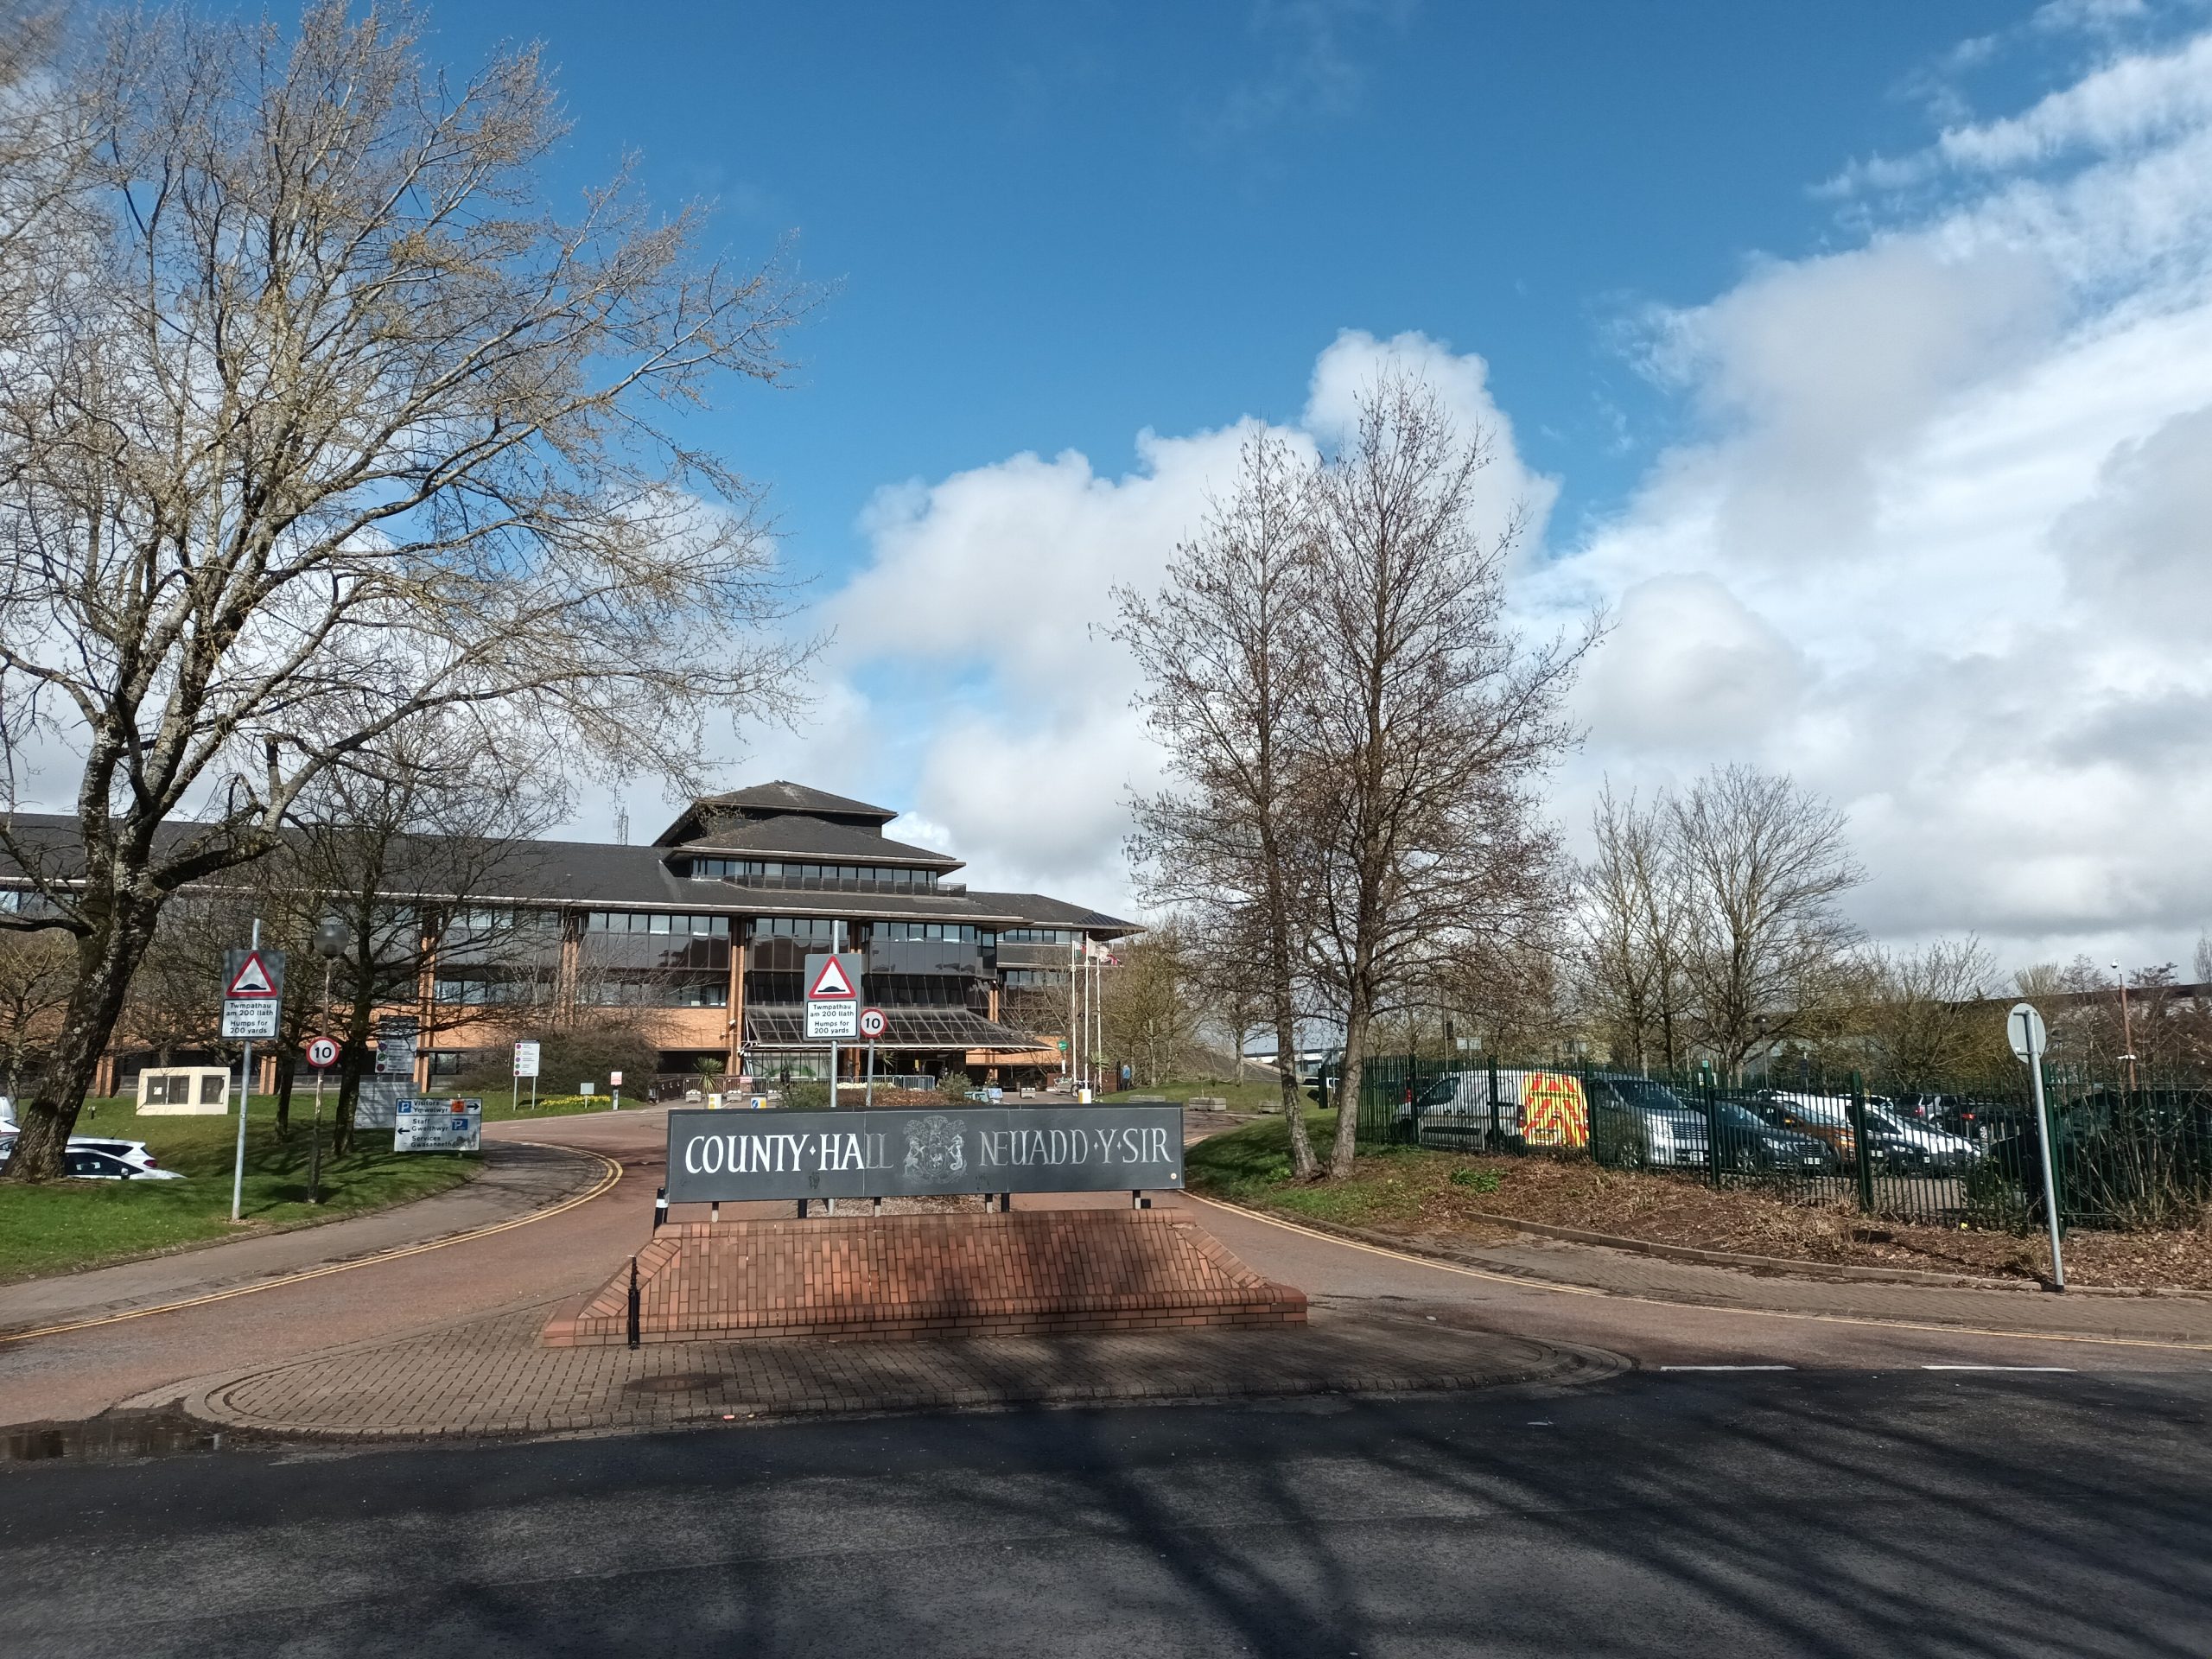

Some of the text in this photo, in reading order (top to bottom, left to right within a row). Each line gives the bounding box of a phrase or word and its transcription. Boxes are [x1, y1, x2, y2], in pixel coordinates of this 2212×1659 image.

[865, 1018, 880, 1029] 10
[315, 1046, 332, 1058] 10
[685, 1134, 810, 1174] COUNTY
[978, 1128, 1089, 1166] NEUADD
[1122, 1128, 1174, 1163] SIR
